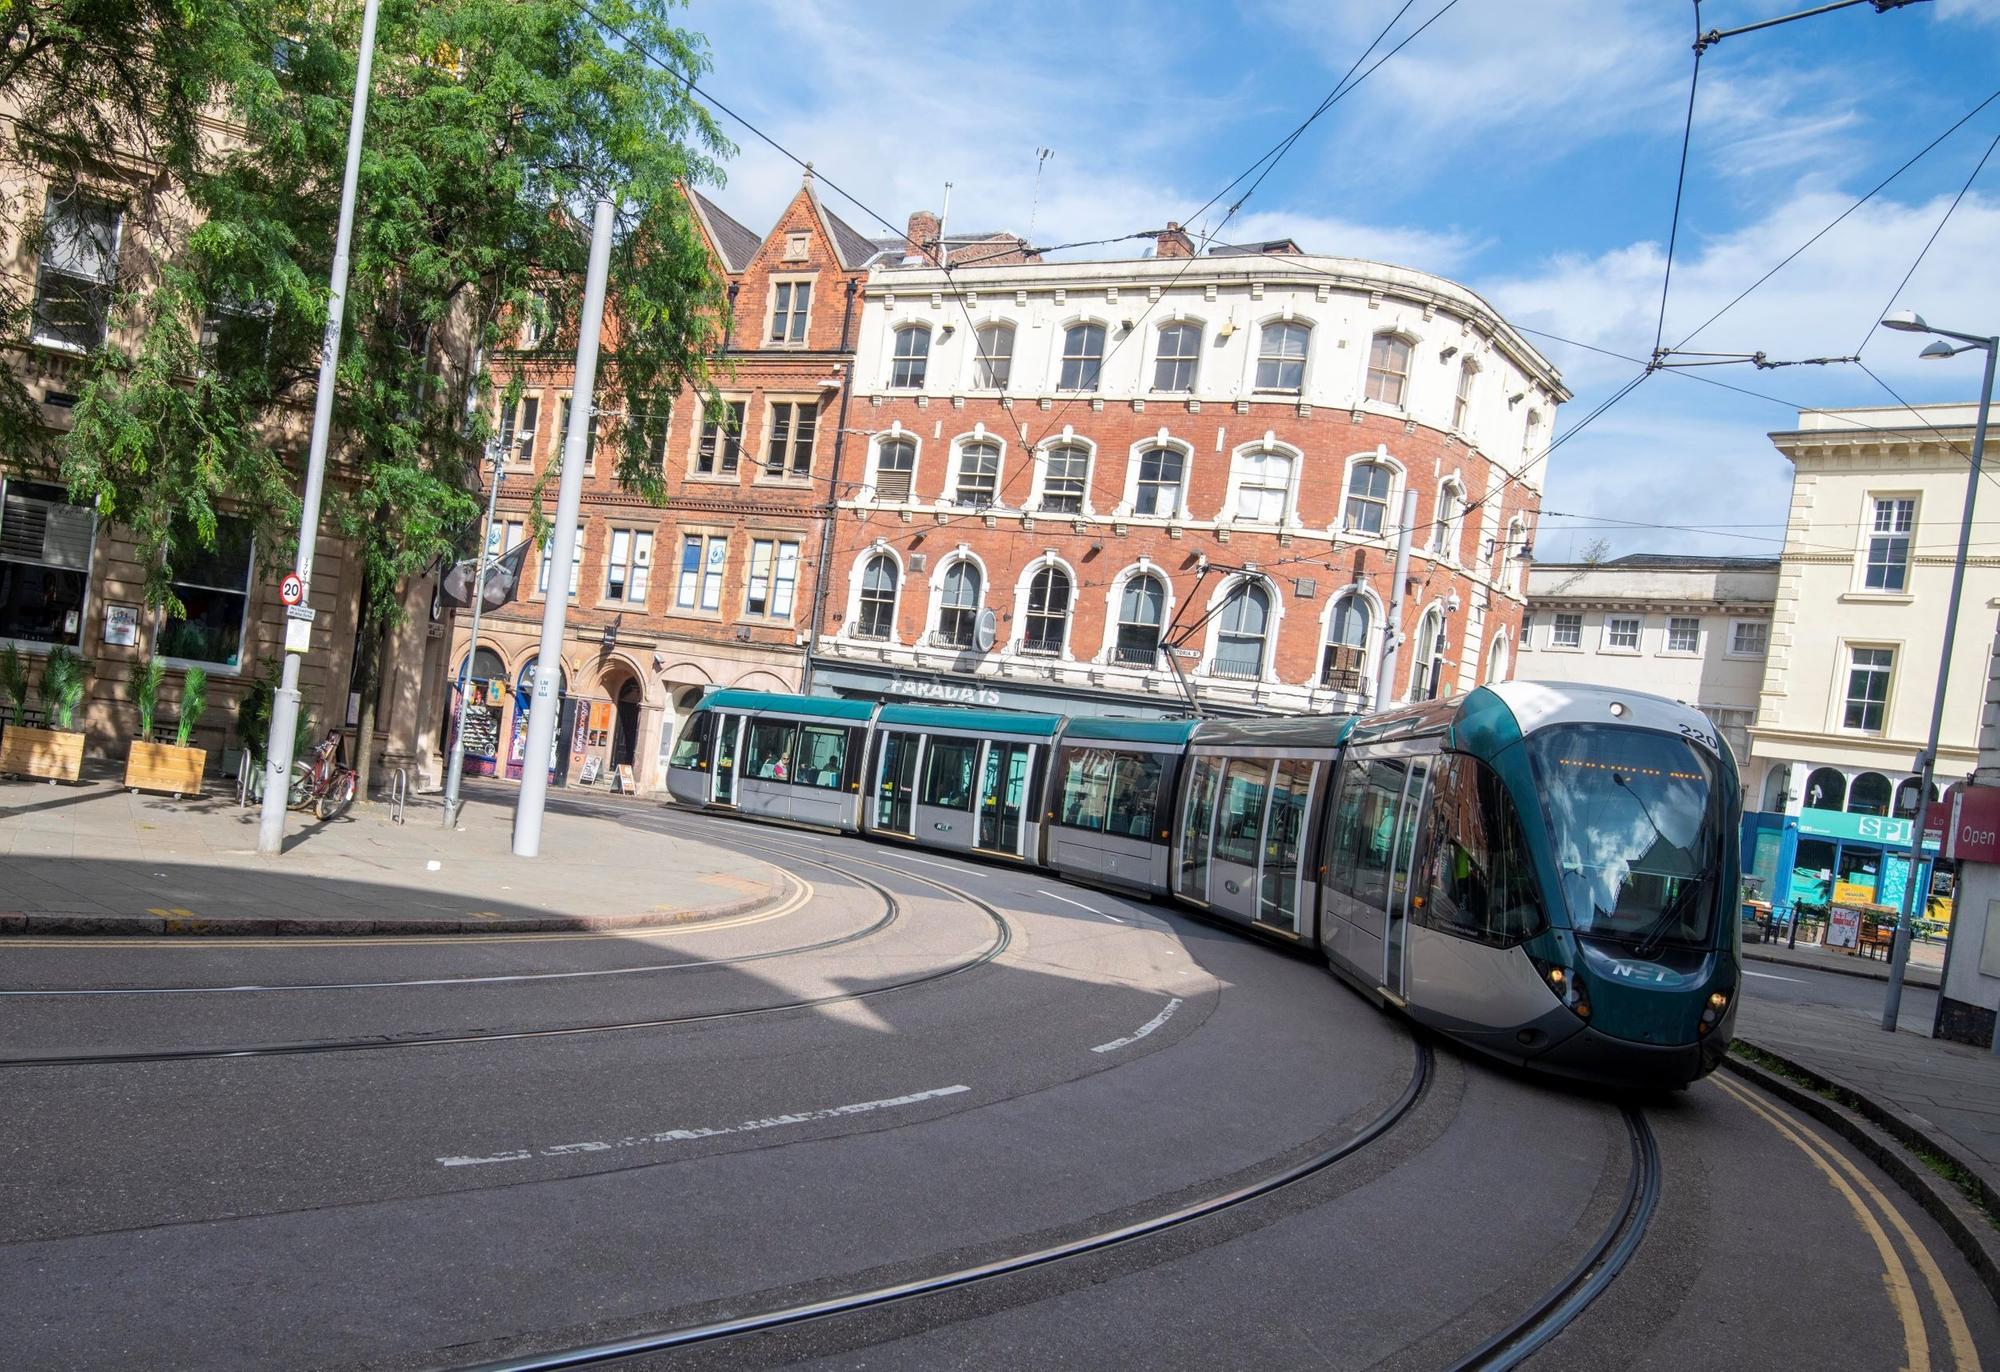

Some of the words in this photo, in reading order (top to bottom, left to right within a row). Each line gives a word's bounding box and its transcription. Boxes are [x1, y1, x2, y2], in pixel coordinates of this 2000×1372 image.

[284, 583, 299, 596] 20
[890, 679, 1000, 705] FARADAYS
[1678, 723, 1718, 749] 220
[1860, 817, 1912, 841] SPI
[1933, 816, 1944, 826] Lo
[1962, 826, 1996, 846] Open
[1612, 964, 1668, 982] NET
